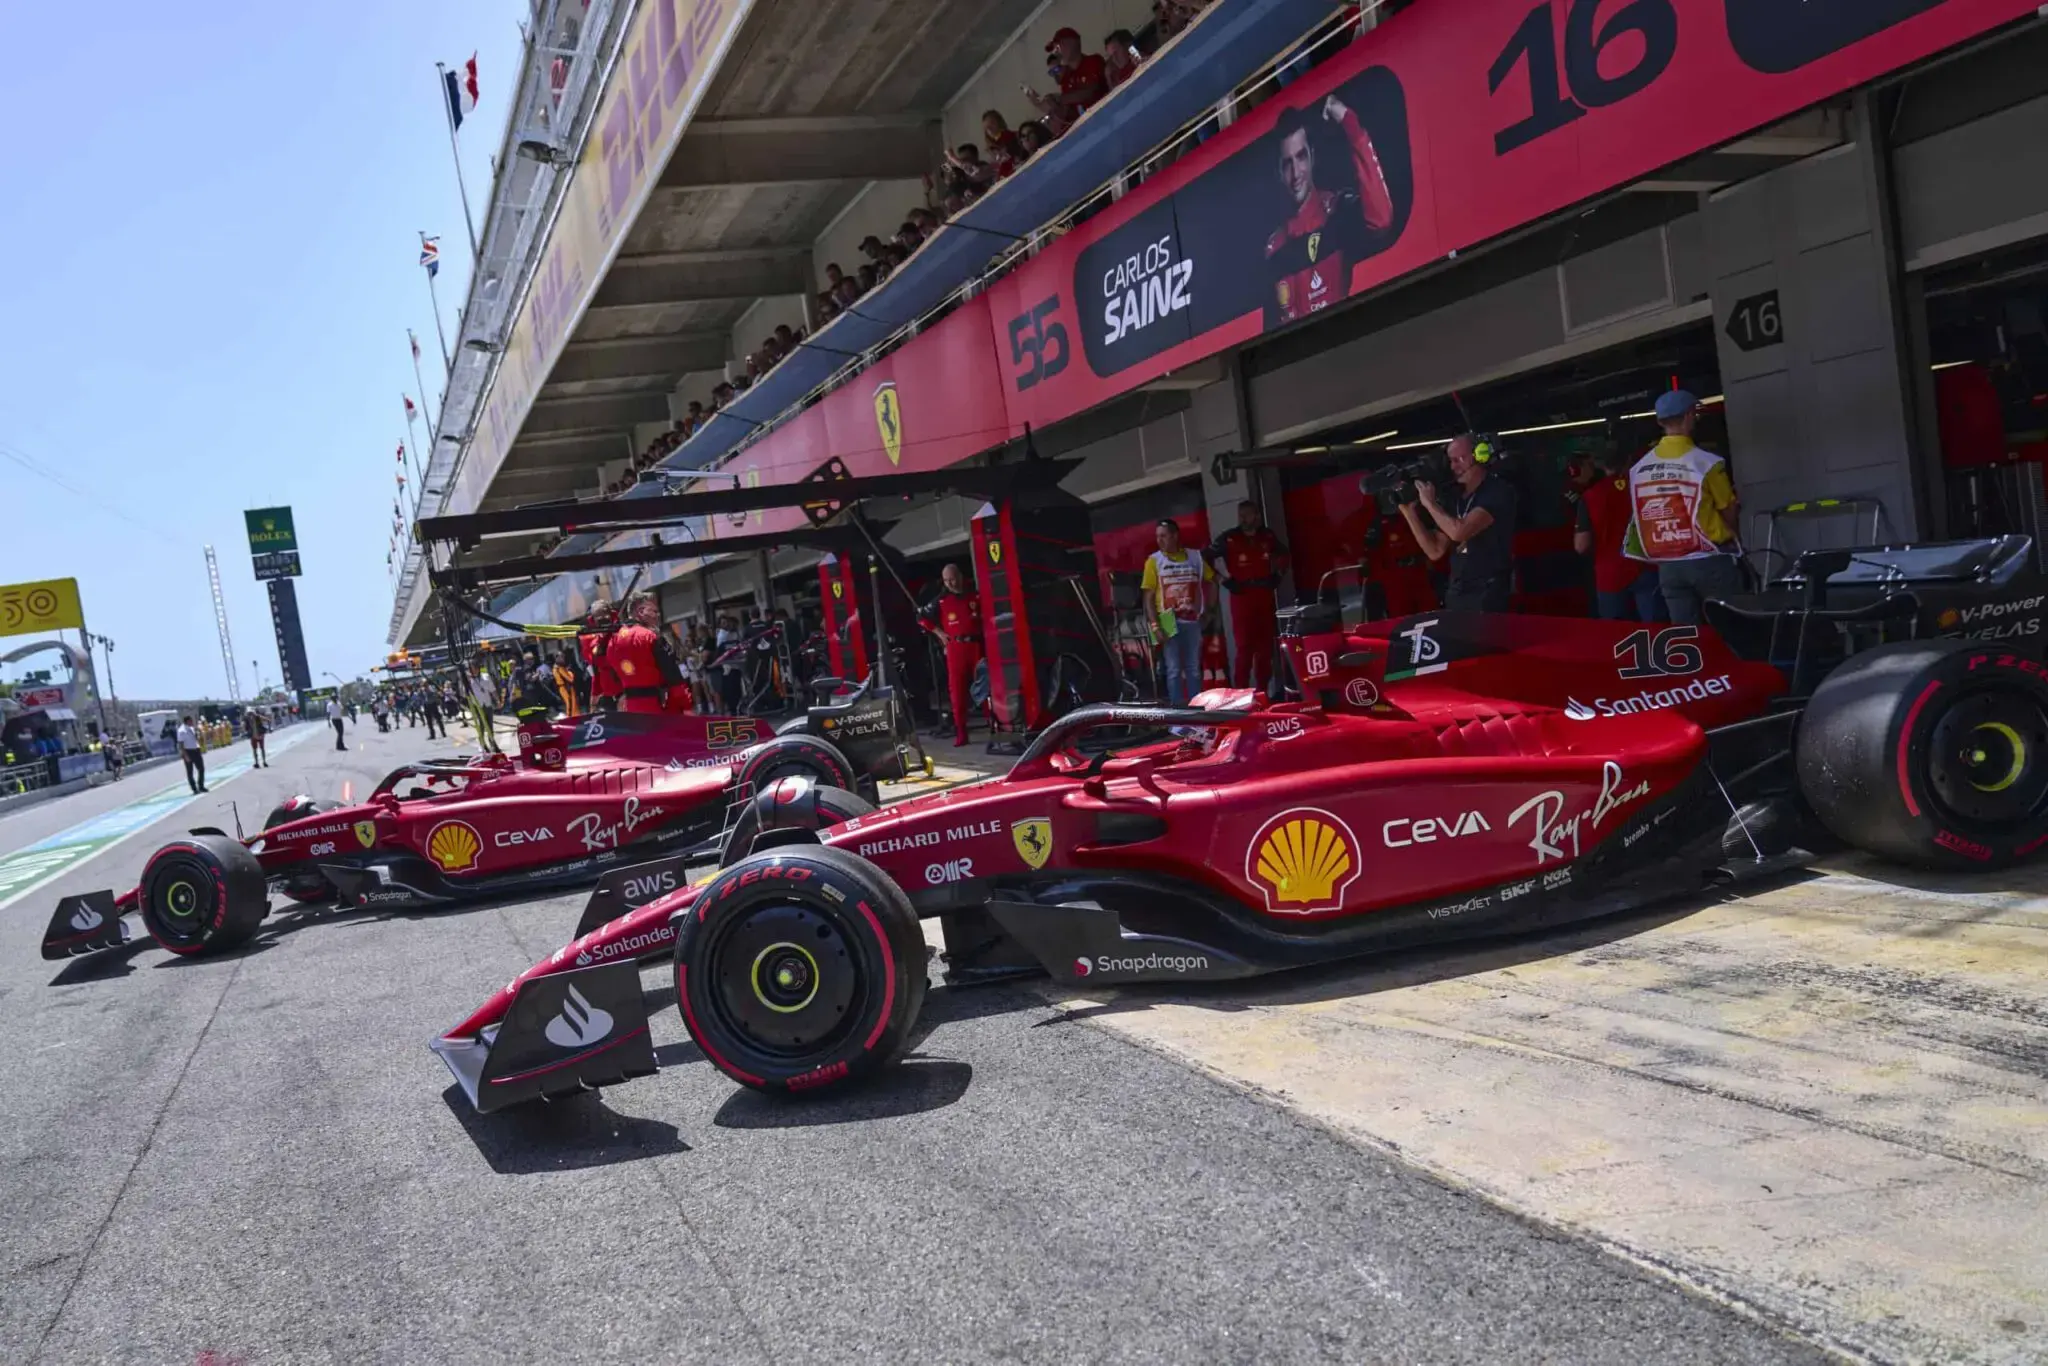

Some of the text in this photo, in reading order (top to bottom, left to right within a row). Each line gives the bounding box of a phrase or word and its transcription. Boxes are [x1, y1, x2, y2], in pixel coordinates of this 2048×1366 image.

[1487, 0, 1678, 156] 16
[1104, 235, 1170, 298] CARLOS
[1104, 258, 1193, 345] SAINZ
[1738, 300, 1781, 343] 16
[1007, 293, 1070, 392] 55
[250, 531, 292, 543] ROLEX
[1960, 595, 2045, 624] V-Power
[1613, 625, 1704, 680] 16
[1594, 674, 1733, 717] Santander
[835, 708, 884, 726] V-Power
[847, 721, 890, 737] VELAS
[1266, 717, 1301, 734] aws
[706, 719, 759, 751] 55
[277, 822, 350, 841] RICHARD MILLE
[859, 819, 1002, 857] RICHARD MILLE
[623, 870, 677, 899] aws
[718, 866, 813, 900] ZERO
[1500, 879, 1537, 902] SKF
[1543, 865, 1573, 885] NGK
[592, 926, 676, 961] Santander
[1097, 952, 1209, 973] Snapdragon
